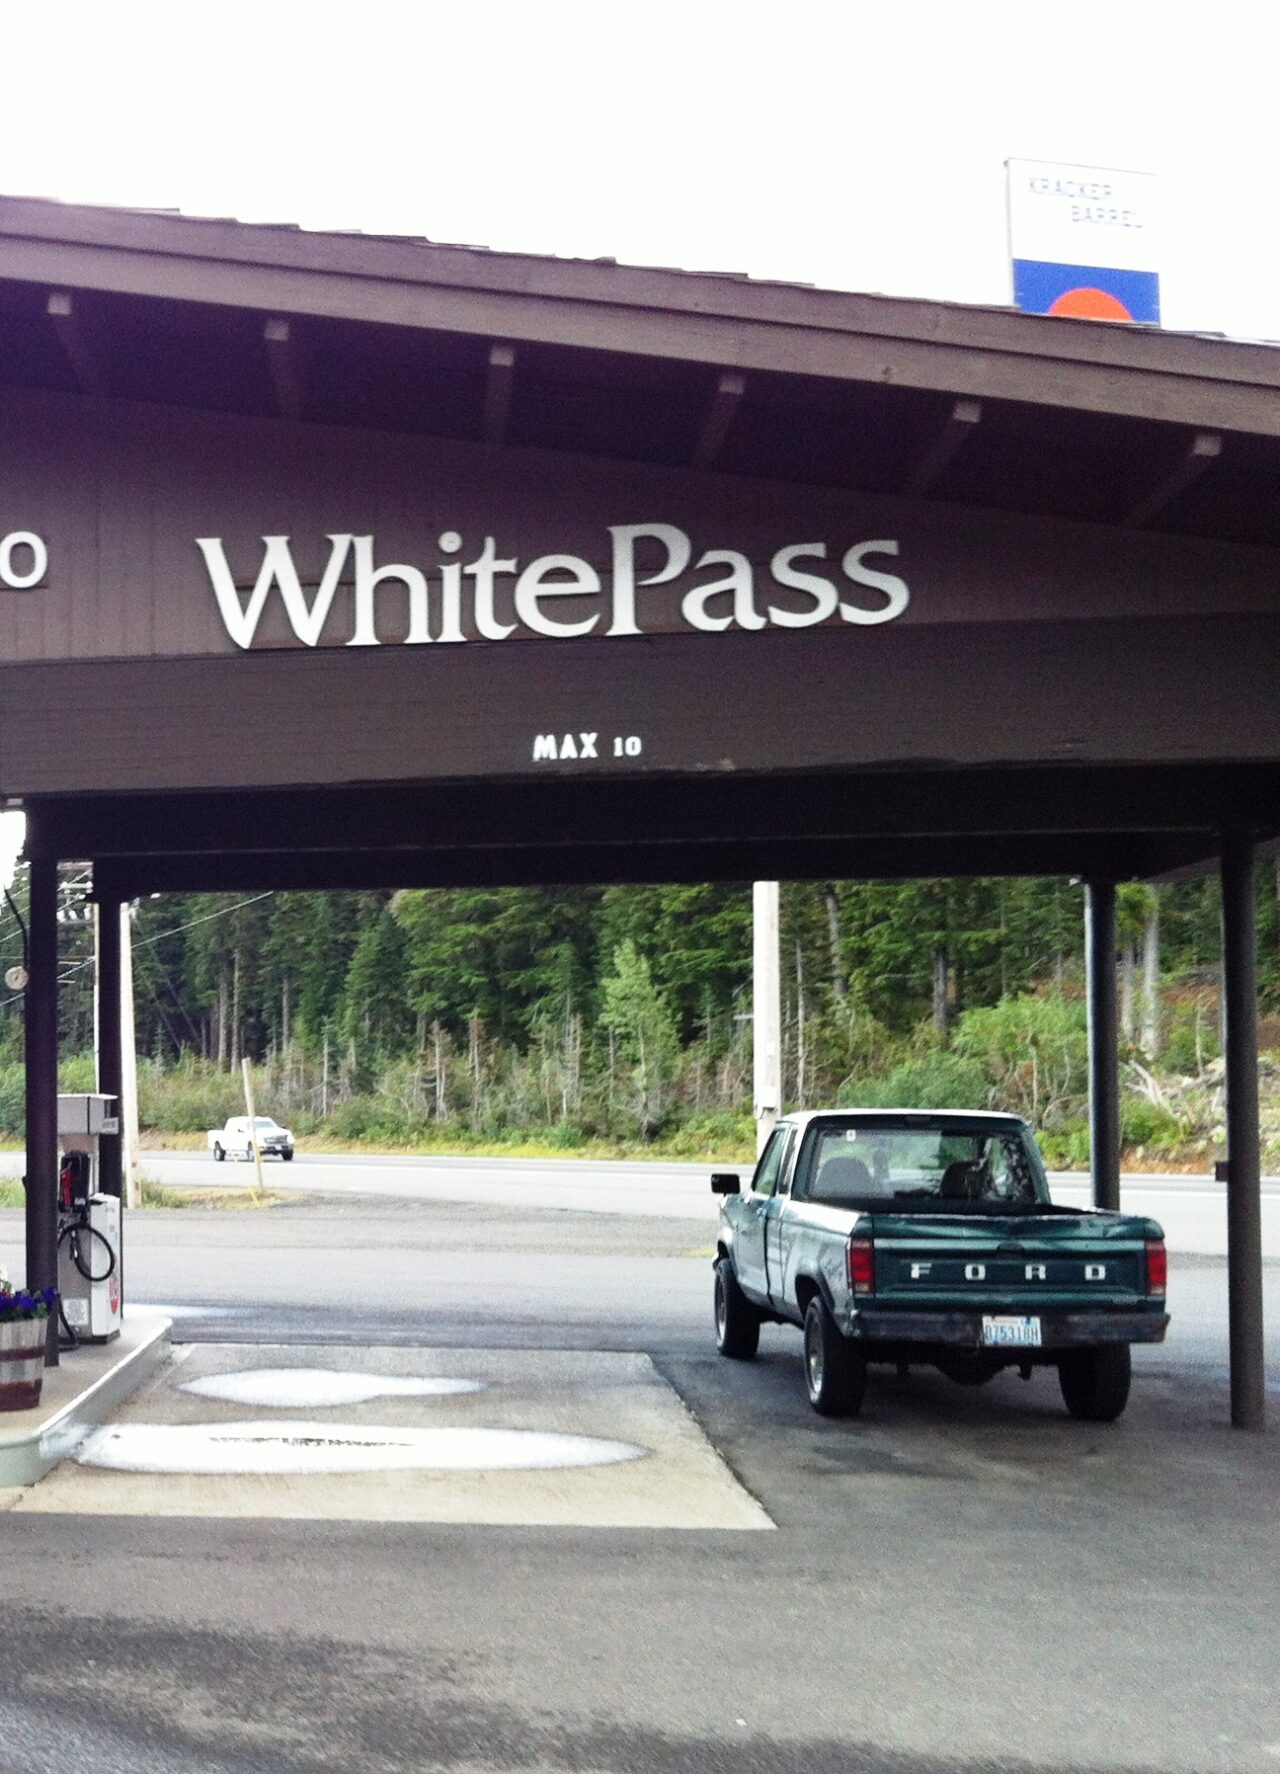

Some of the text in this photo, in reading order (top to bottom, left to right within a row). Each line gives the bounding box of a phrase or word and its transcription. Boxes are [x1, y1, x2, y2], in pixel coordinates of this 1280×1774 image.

[194, 522, 912, 652] WhitePass
[532, 732, 642, 761] MAX 10
[910, 1262, 1107, 1281] FORD
